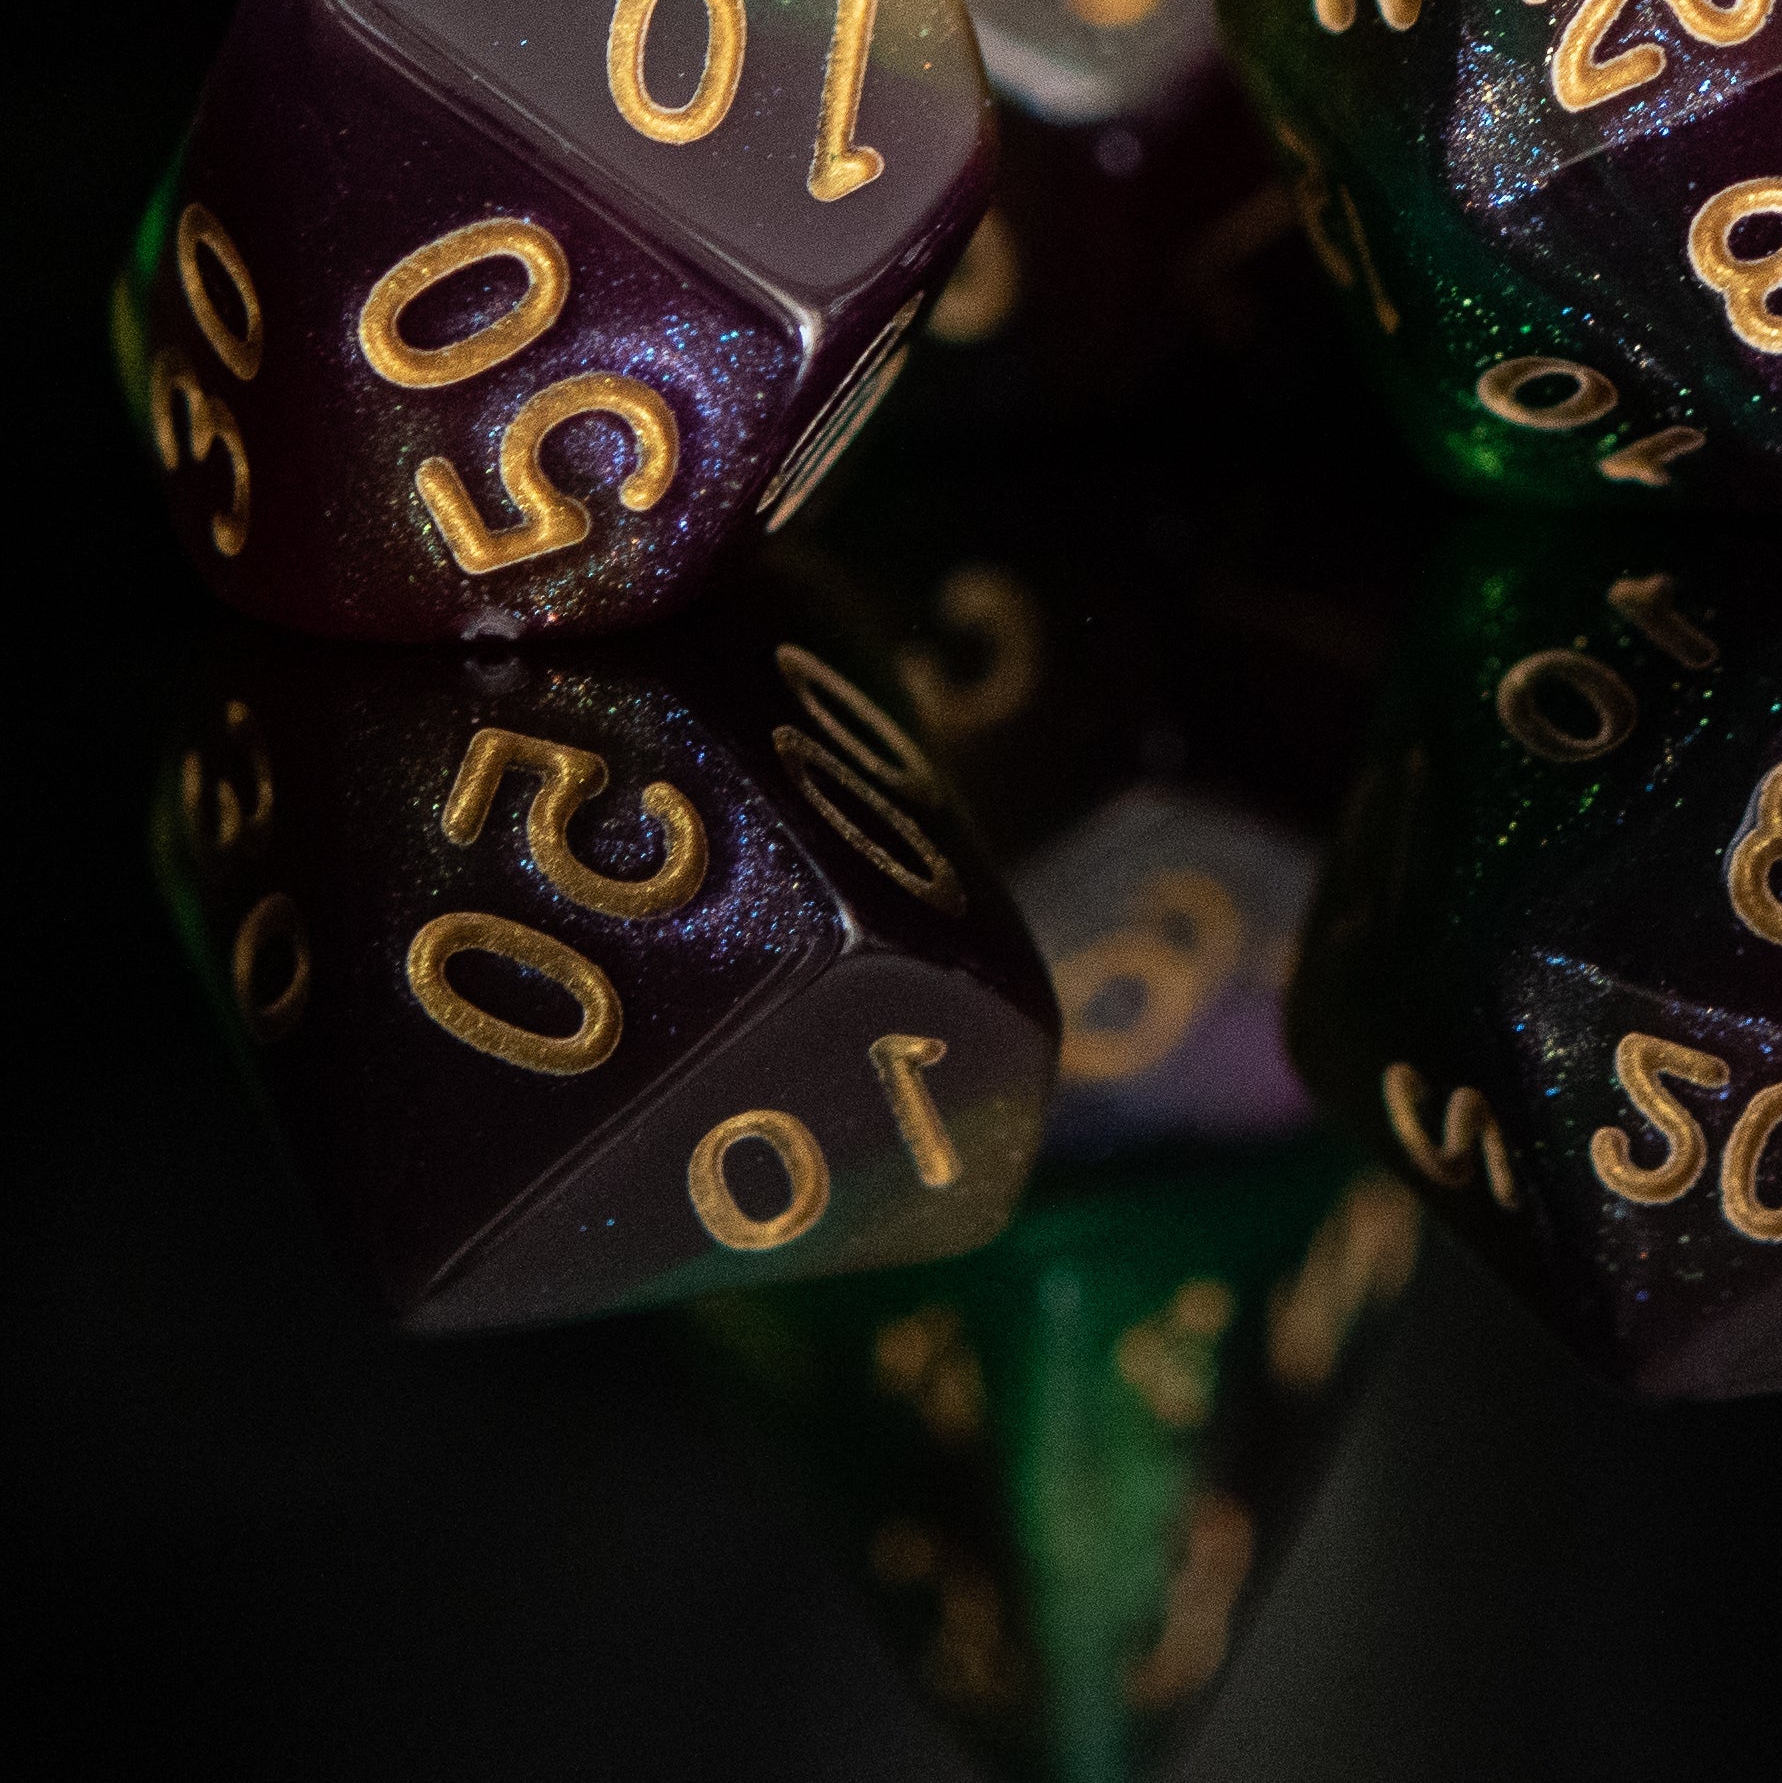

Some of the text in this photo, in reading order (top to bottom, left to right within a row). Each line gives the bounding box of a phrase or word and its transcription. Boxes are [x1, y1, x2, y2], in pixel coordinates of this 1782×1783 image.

[150, 203, 265, 558] 30
[358, 218, 678, 576] 50
[1475, 353, 1708, 488] 10
